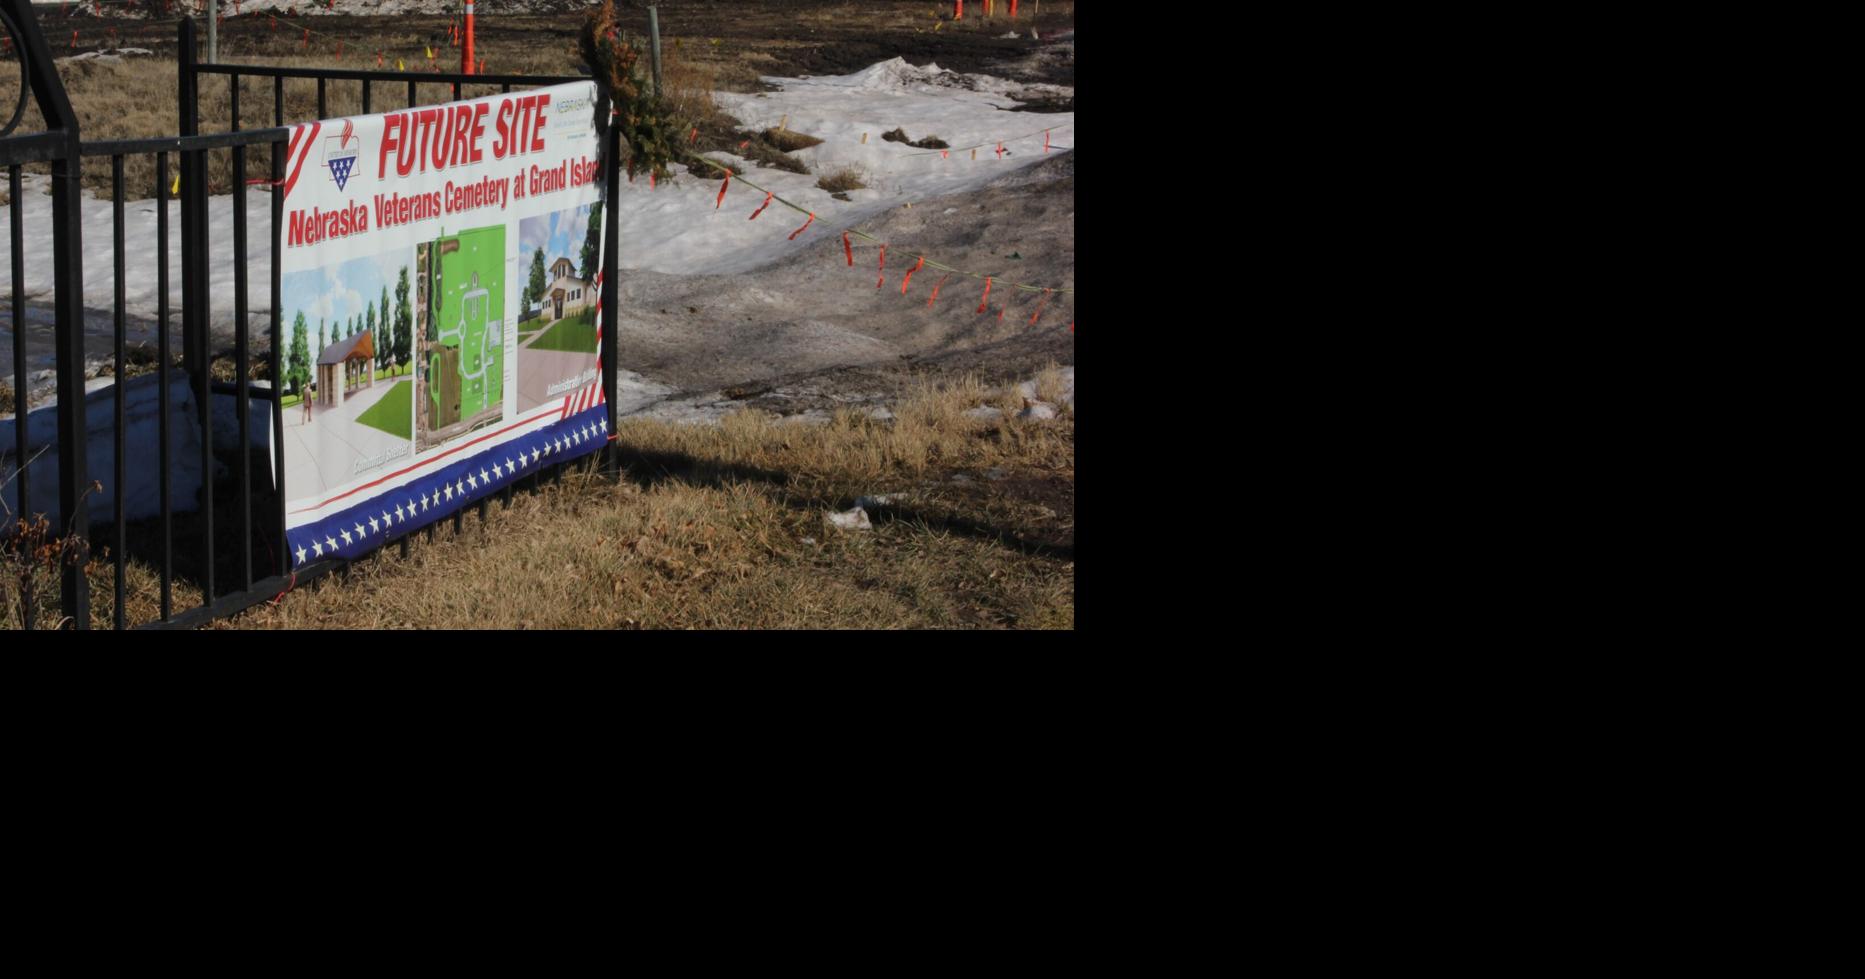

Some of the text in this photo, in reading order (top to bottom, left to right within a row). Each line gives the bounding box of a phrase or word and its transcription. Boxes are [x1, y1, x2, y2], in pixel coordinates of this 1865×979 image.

[379, 94, 551, 180] FUTURE SITE
[287, 155, 601, 248] Nebraska Veterans Cemetery at Grand Islan
